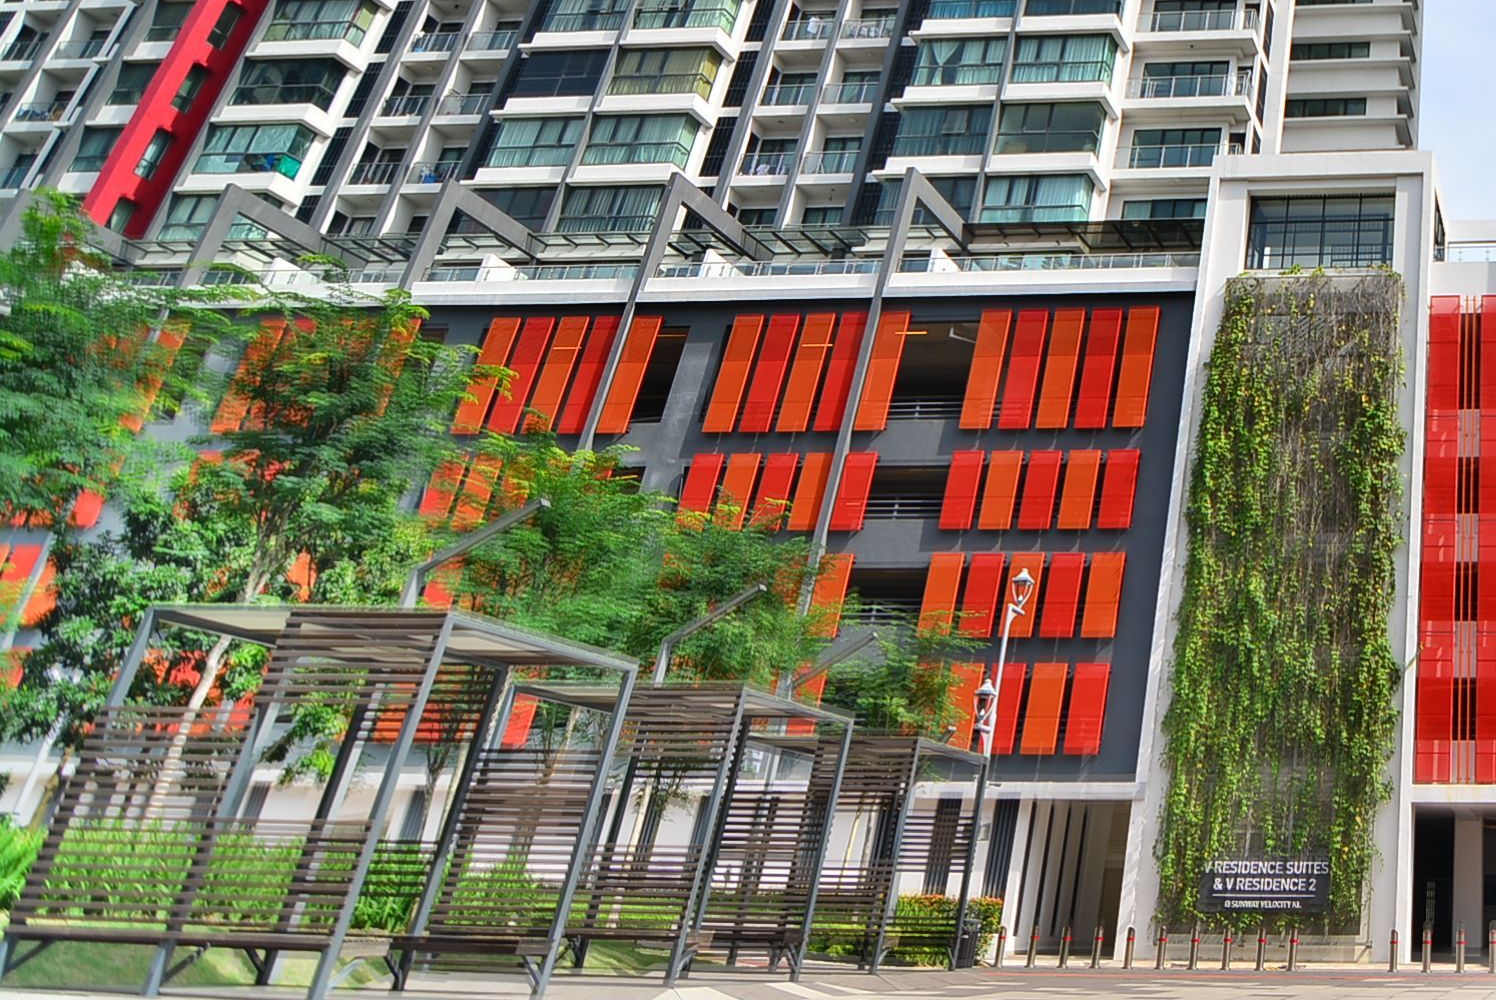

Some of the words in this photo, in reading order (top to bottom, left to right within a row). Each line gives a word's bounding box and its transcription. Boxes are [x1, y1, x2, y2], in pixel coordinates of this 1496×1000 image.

[1214, 861, 1284, 874] RESIDENCE
[1285, 861, 1329, 874] SUITES
[1213, 877, 1223, 891] &
[1226, 877, 1235, 891] V
[1236, 877, 1306, 891] RESIDENCE
[1308, 878, 1317, 891] 2
[1231, 900, 1260, 908] SUNWAY
[1260, 900, 1292, 908] VELOCITY
